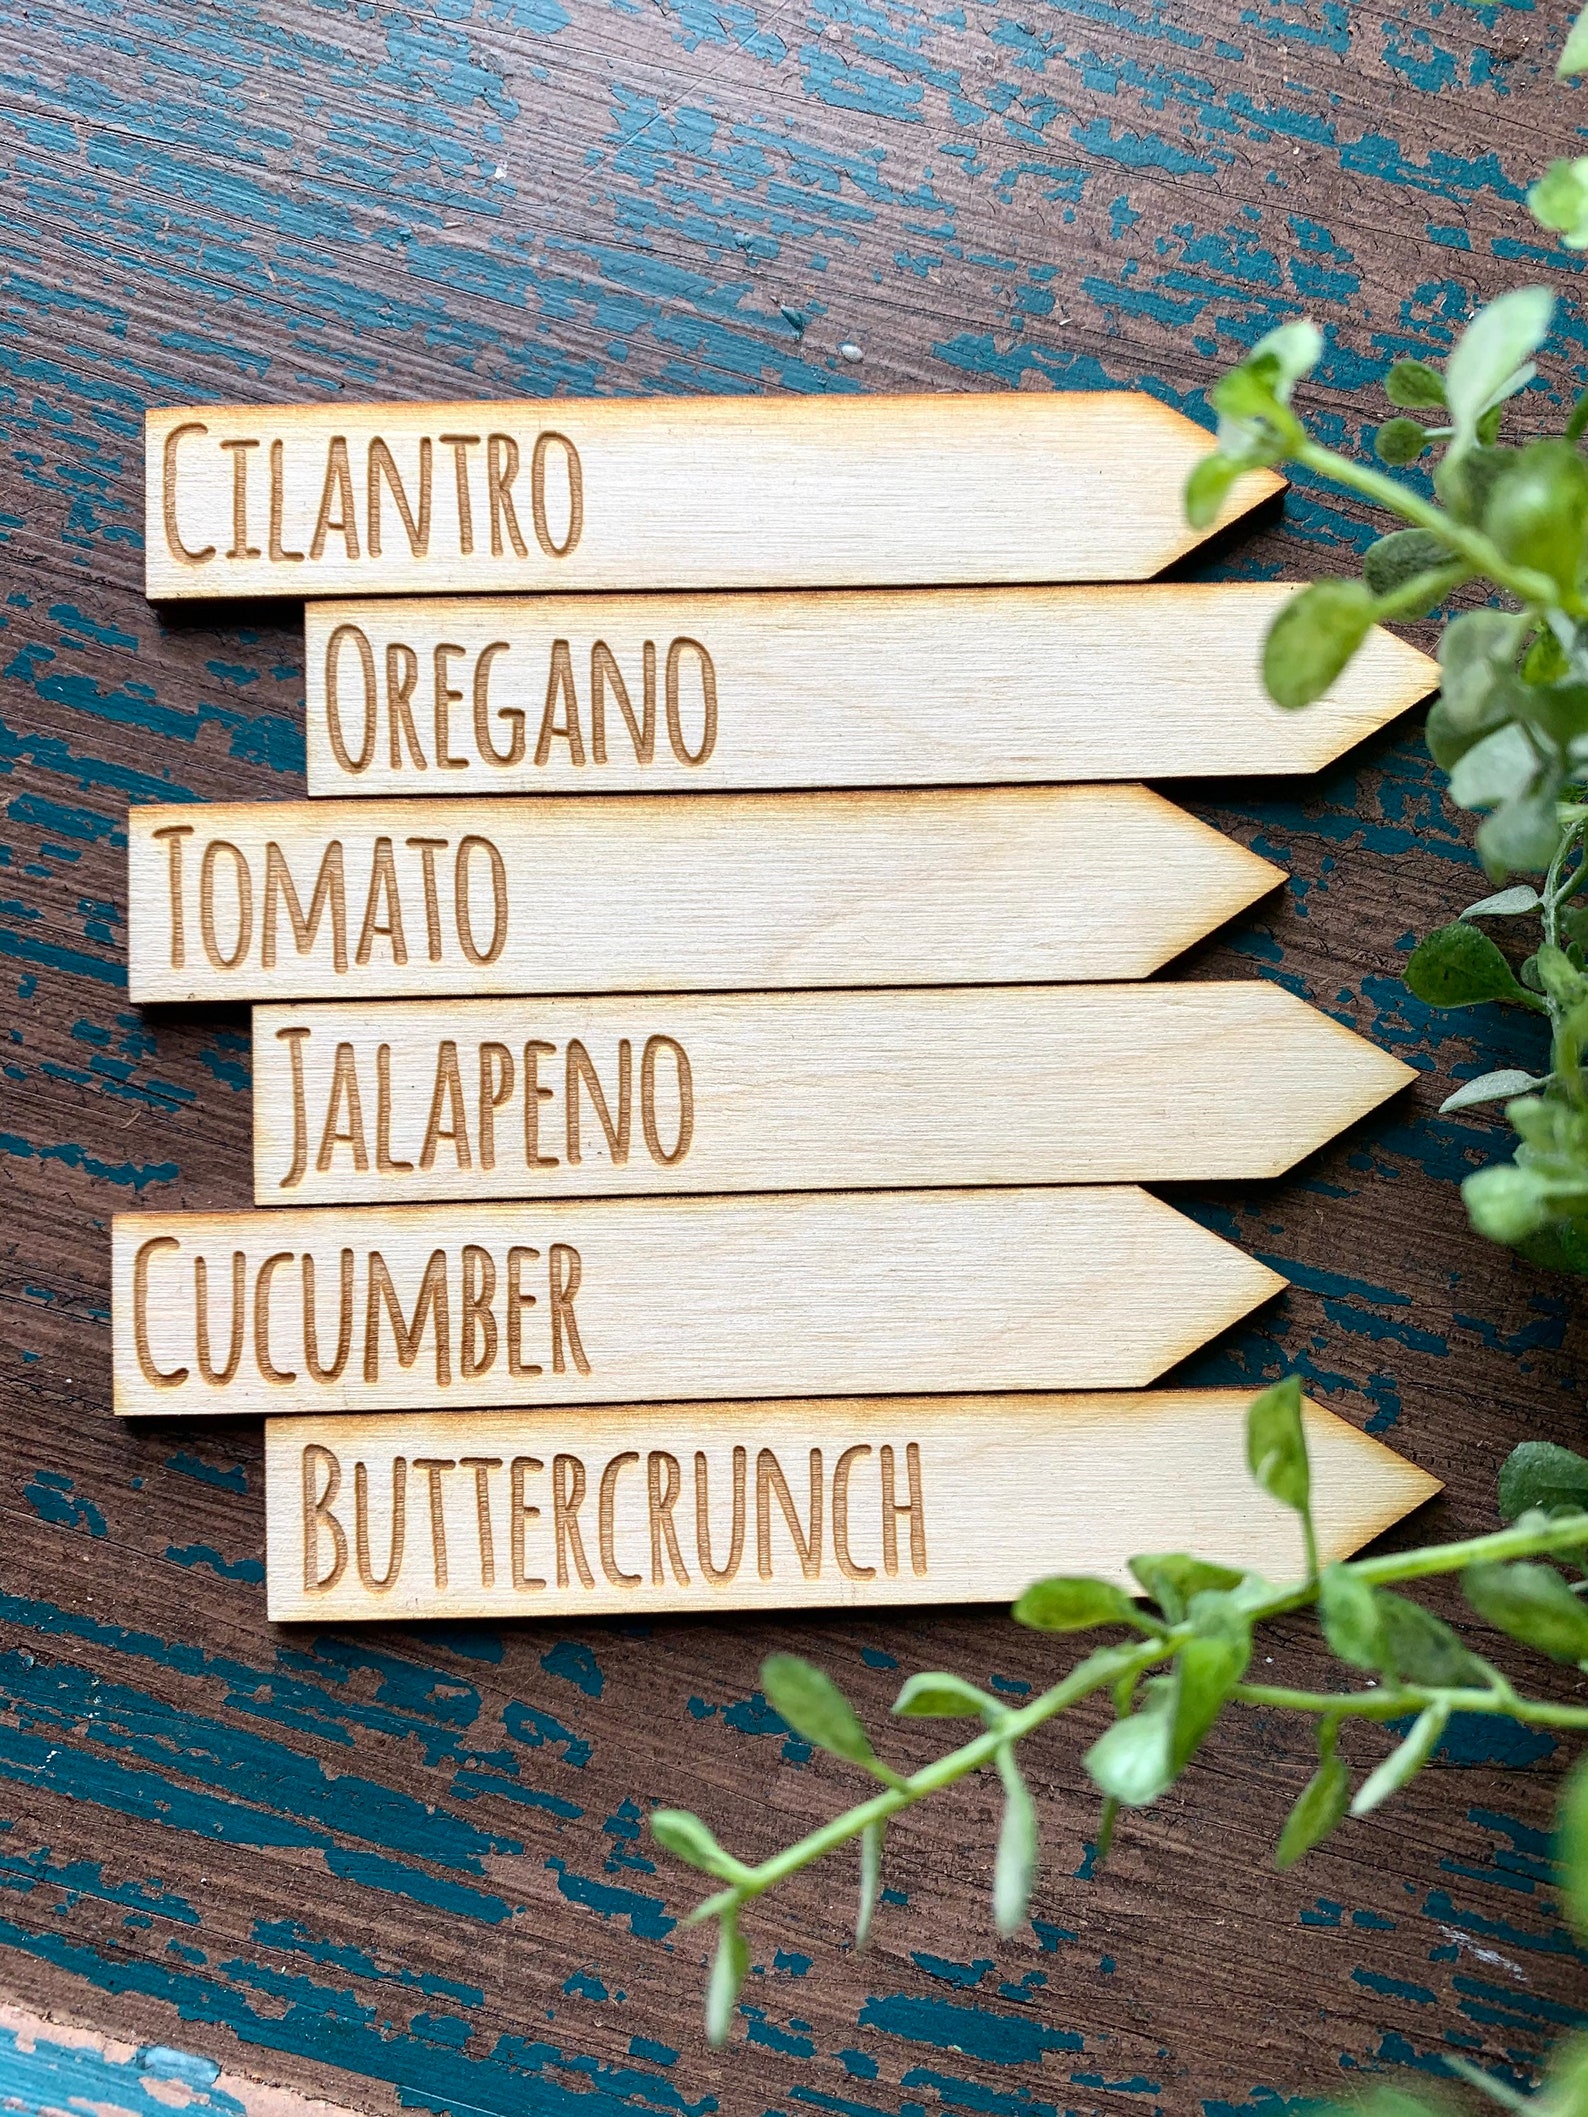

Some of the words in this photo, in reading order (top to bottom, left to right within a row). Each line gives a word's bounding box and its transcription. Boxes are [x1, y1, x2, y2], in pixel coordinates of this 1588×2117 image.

[162, 422, 584, 563] CILANTRO
[326, 623, 719, 775] OREGANO
[153, 826, 509, 974] TOMATO
[274, 1026, 695, 1189] JALAPENO
[134, 1236, 592, 1387] CUCUMBER
[301, 1440, 928, 1593] BUTTERCRUNCH
